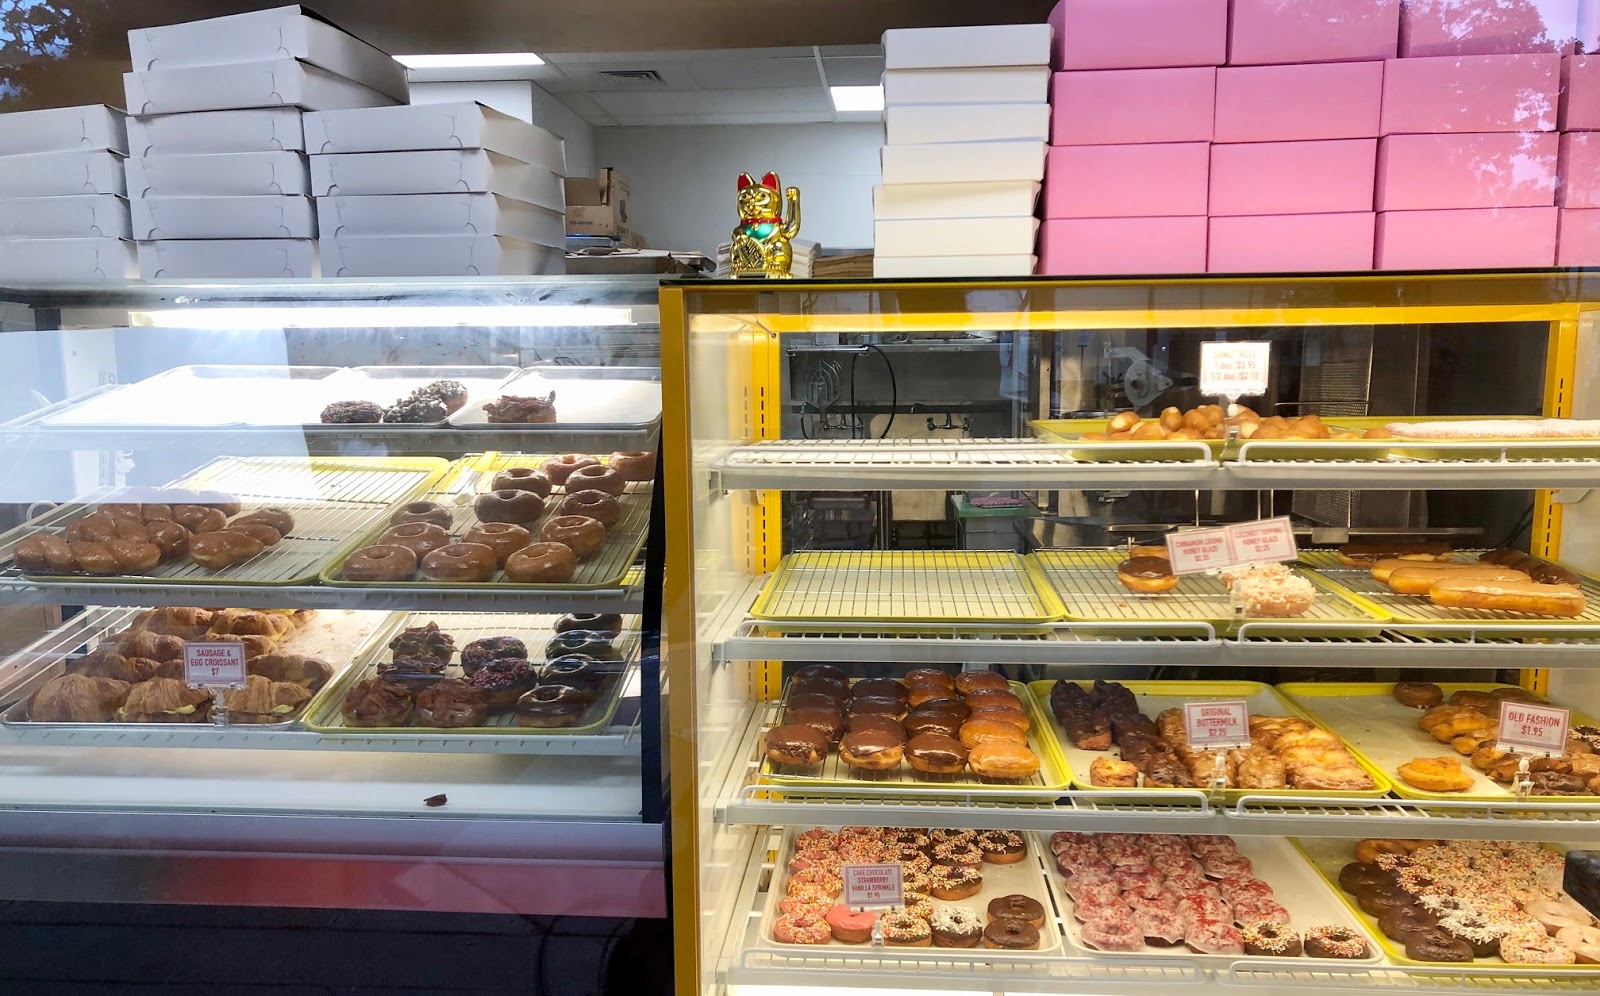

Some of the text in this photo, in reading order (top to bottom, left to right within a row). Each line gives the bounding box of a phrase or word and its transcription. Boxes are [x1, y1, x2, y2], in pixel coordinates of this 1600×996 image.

[196, 649, 225, 657] SAUSAGE
[190, 658, 239, 667] EGG CROISSANT
[211, 667, 219, 676] $7
[1201, 708, 1232, 717] ORIGINAL
[1196, 718, 1237, 728] BUTTERMILK
[1508, 711, 1560, 727] OLD FASHION
[1208, 728, 1227, 737] $2.25
[1521, 724, 1543, 737] $1.95
[857, 876, 888, 884] STRAWBERRY
[851, 883, 895, 892] VANILLA SPRINKLE
